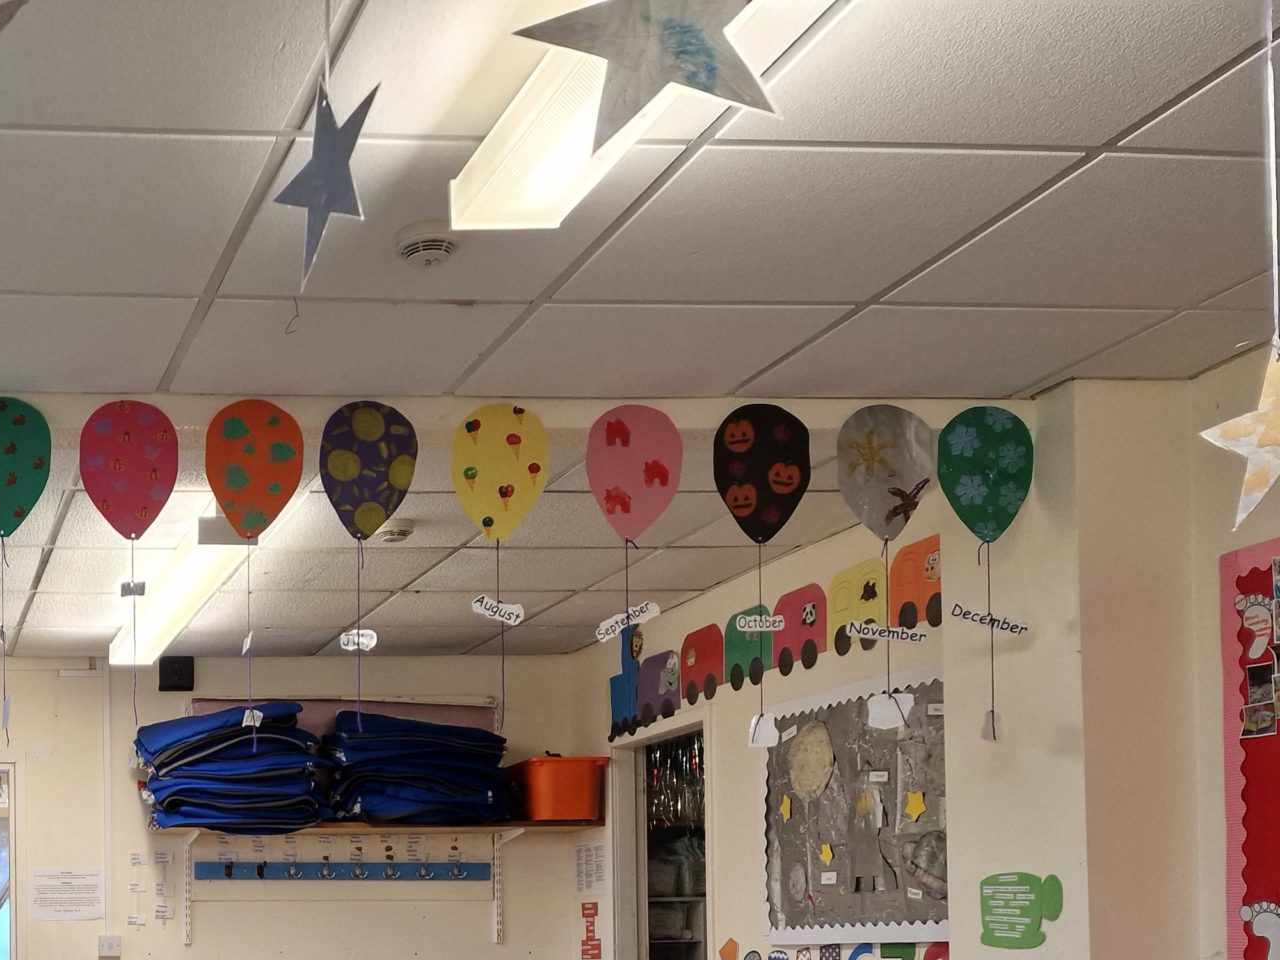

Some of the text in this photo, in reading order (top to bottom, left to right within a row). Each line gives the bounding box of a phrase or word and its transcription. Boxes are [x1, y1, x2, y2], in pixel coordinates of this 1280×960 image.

[474, 595, 521, 624] August
[596, 602, 650, 640] September
[737, 617, 784, 629] October
[951, 603, 1028, 635] December
[848, 622, 927, 642] November
